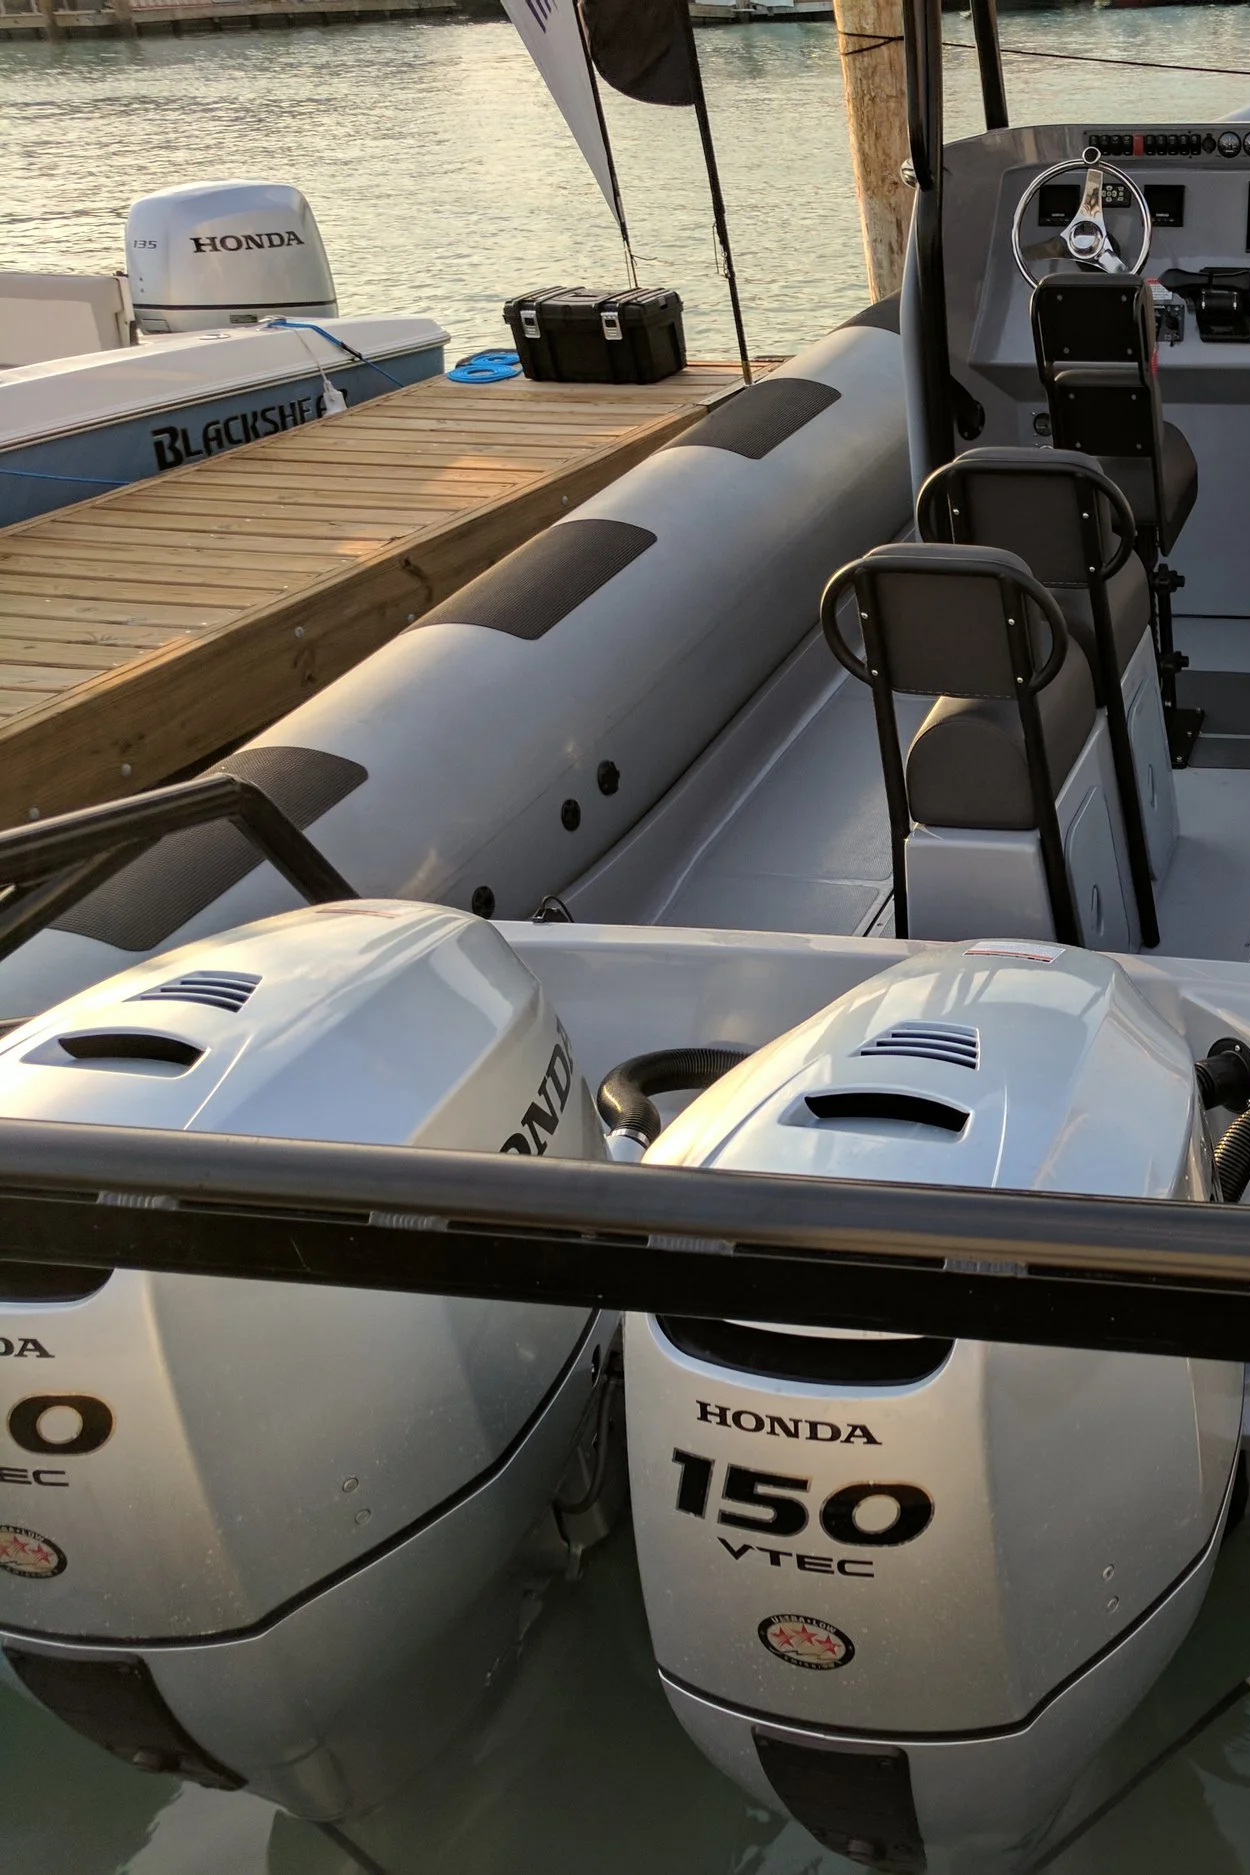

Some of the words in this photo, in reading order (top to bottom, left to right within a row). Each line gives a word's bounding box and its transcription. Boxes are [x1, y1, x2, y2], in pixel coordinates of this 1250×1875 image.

[133, 239, 157, 249] 135
[189, 231, 304, 253] HONDA
[499, 1014, 574, 1157] NDA
[696, 1400, 882, 1445] HONDA
[672, 1447, 935, 1547] 150
[717, 1537, 875, 1578] VTEC
